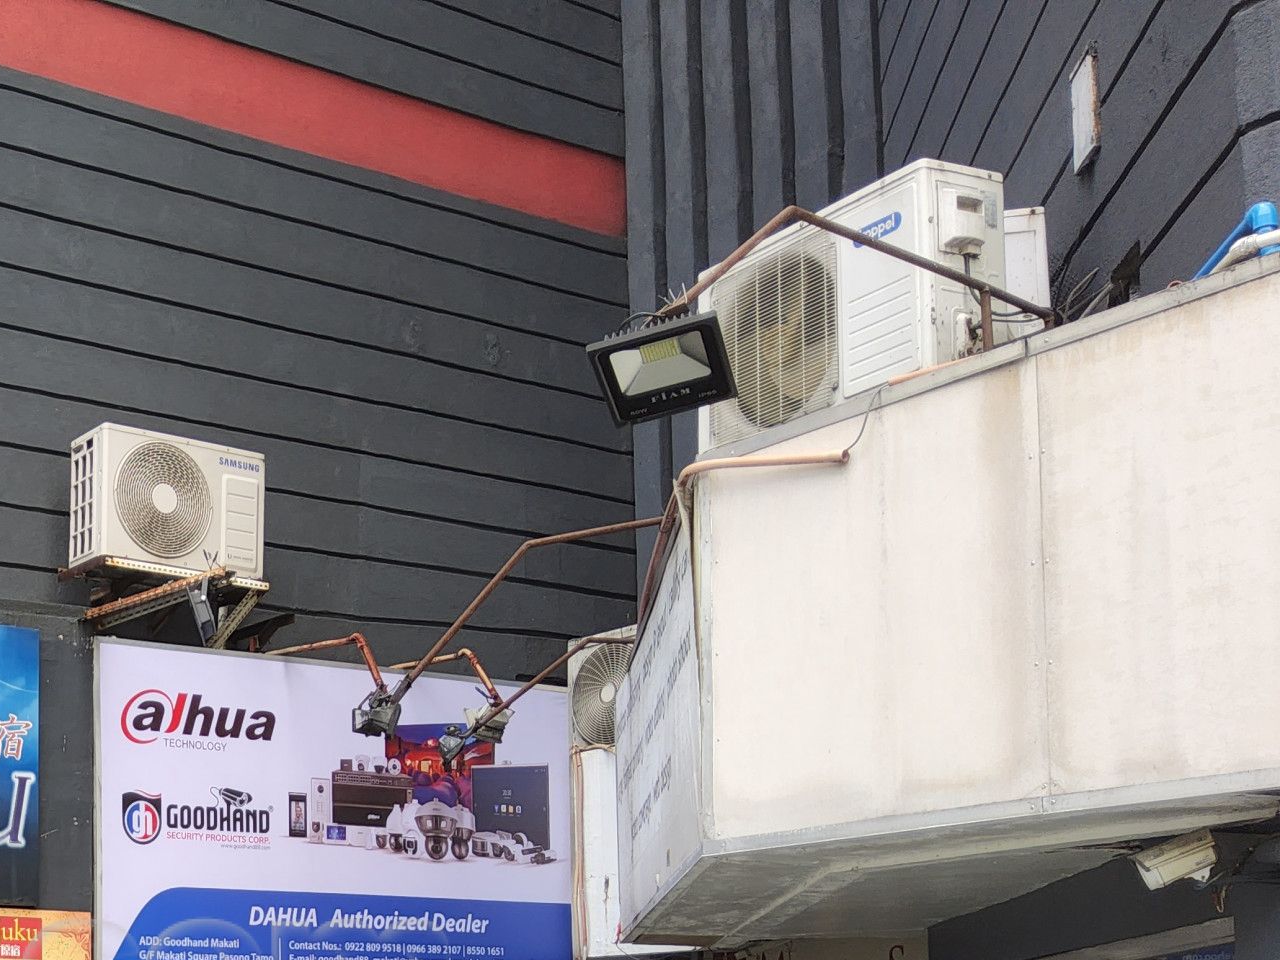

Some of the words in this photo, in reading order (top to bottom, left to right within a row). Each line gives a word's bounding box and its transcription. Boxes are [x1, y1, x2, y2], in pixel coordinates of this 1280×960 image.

[219, 456, 260, 473] SAMSUNG
[163, 738, 227, 751] TECHNOLOGY
[166, 803, 271, 834] GOODHAND
[166, 831, 204, 842] SECURITY
[205, 833, 247, 844] PRODUCTS
[248, 835, 271, 844] CORP.
[249, 906, 318, 927] DAHUA
[330, 908, 428, 931] Authorized
[432, 912, 489, 934] Dealer
[139, 936, 162, 946] ADD:
[163, 936, 209, 947] Goodhand
[210, 938, 239, 948] Makati
[289, 940, 320, 950] Contact
[344, 942, 365, 952] 0922
[366, 943, 381, 952] 809
[407, 945, 426, 954] 0966
[428, 945, 442, 955] 389
[443, 946, 461, 955] 2107
[467, 946, 485, 955] 8550
[487, 946, 504, 956] 1651
[139, 951, 155, 960] G/F
[156, 951, 186, 960] Makati
